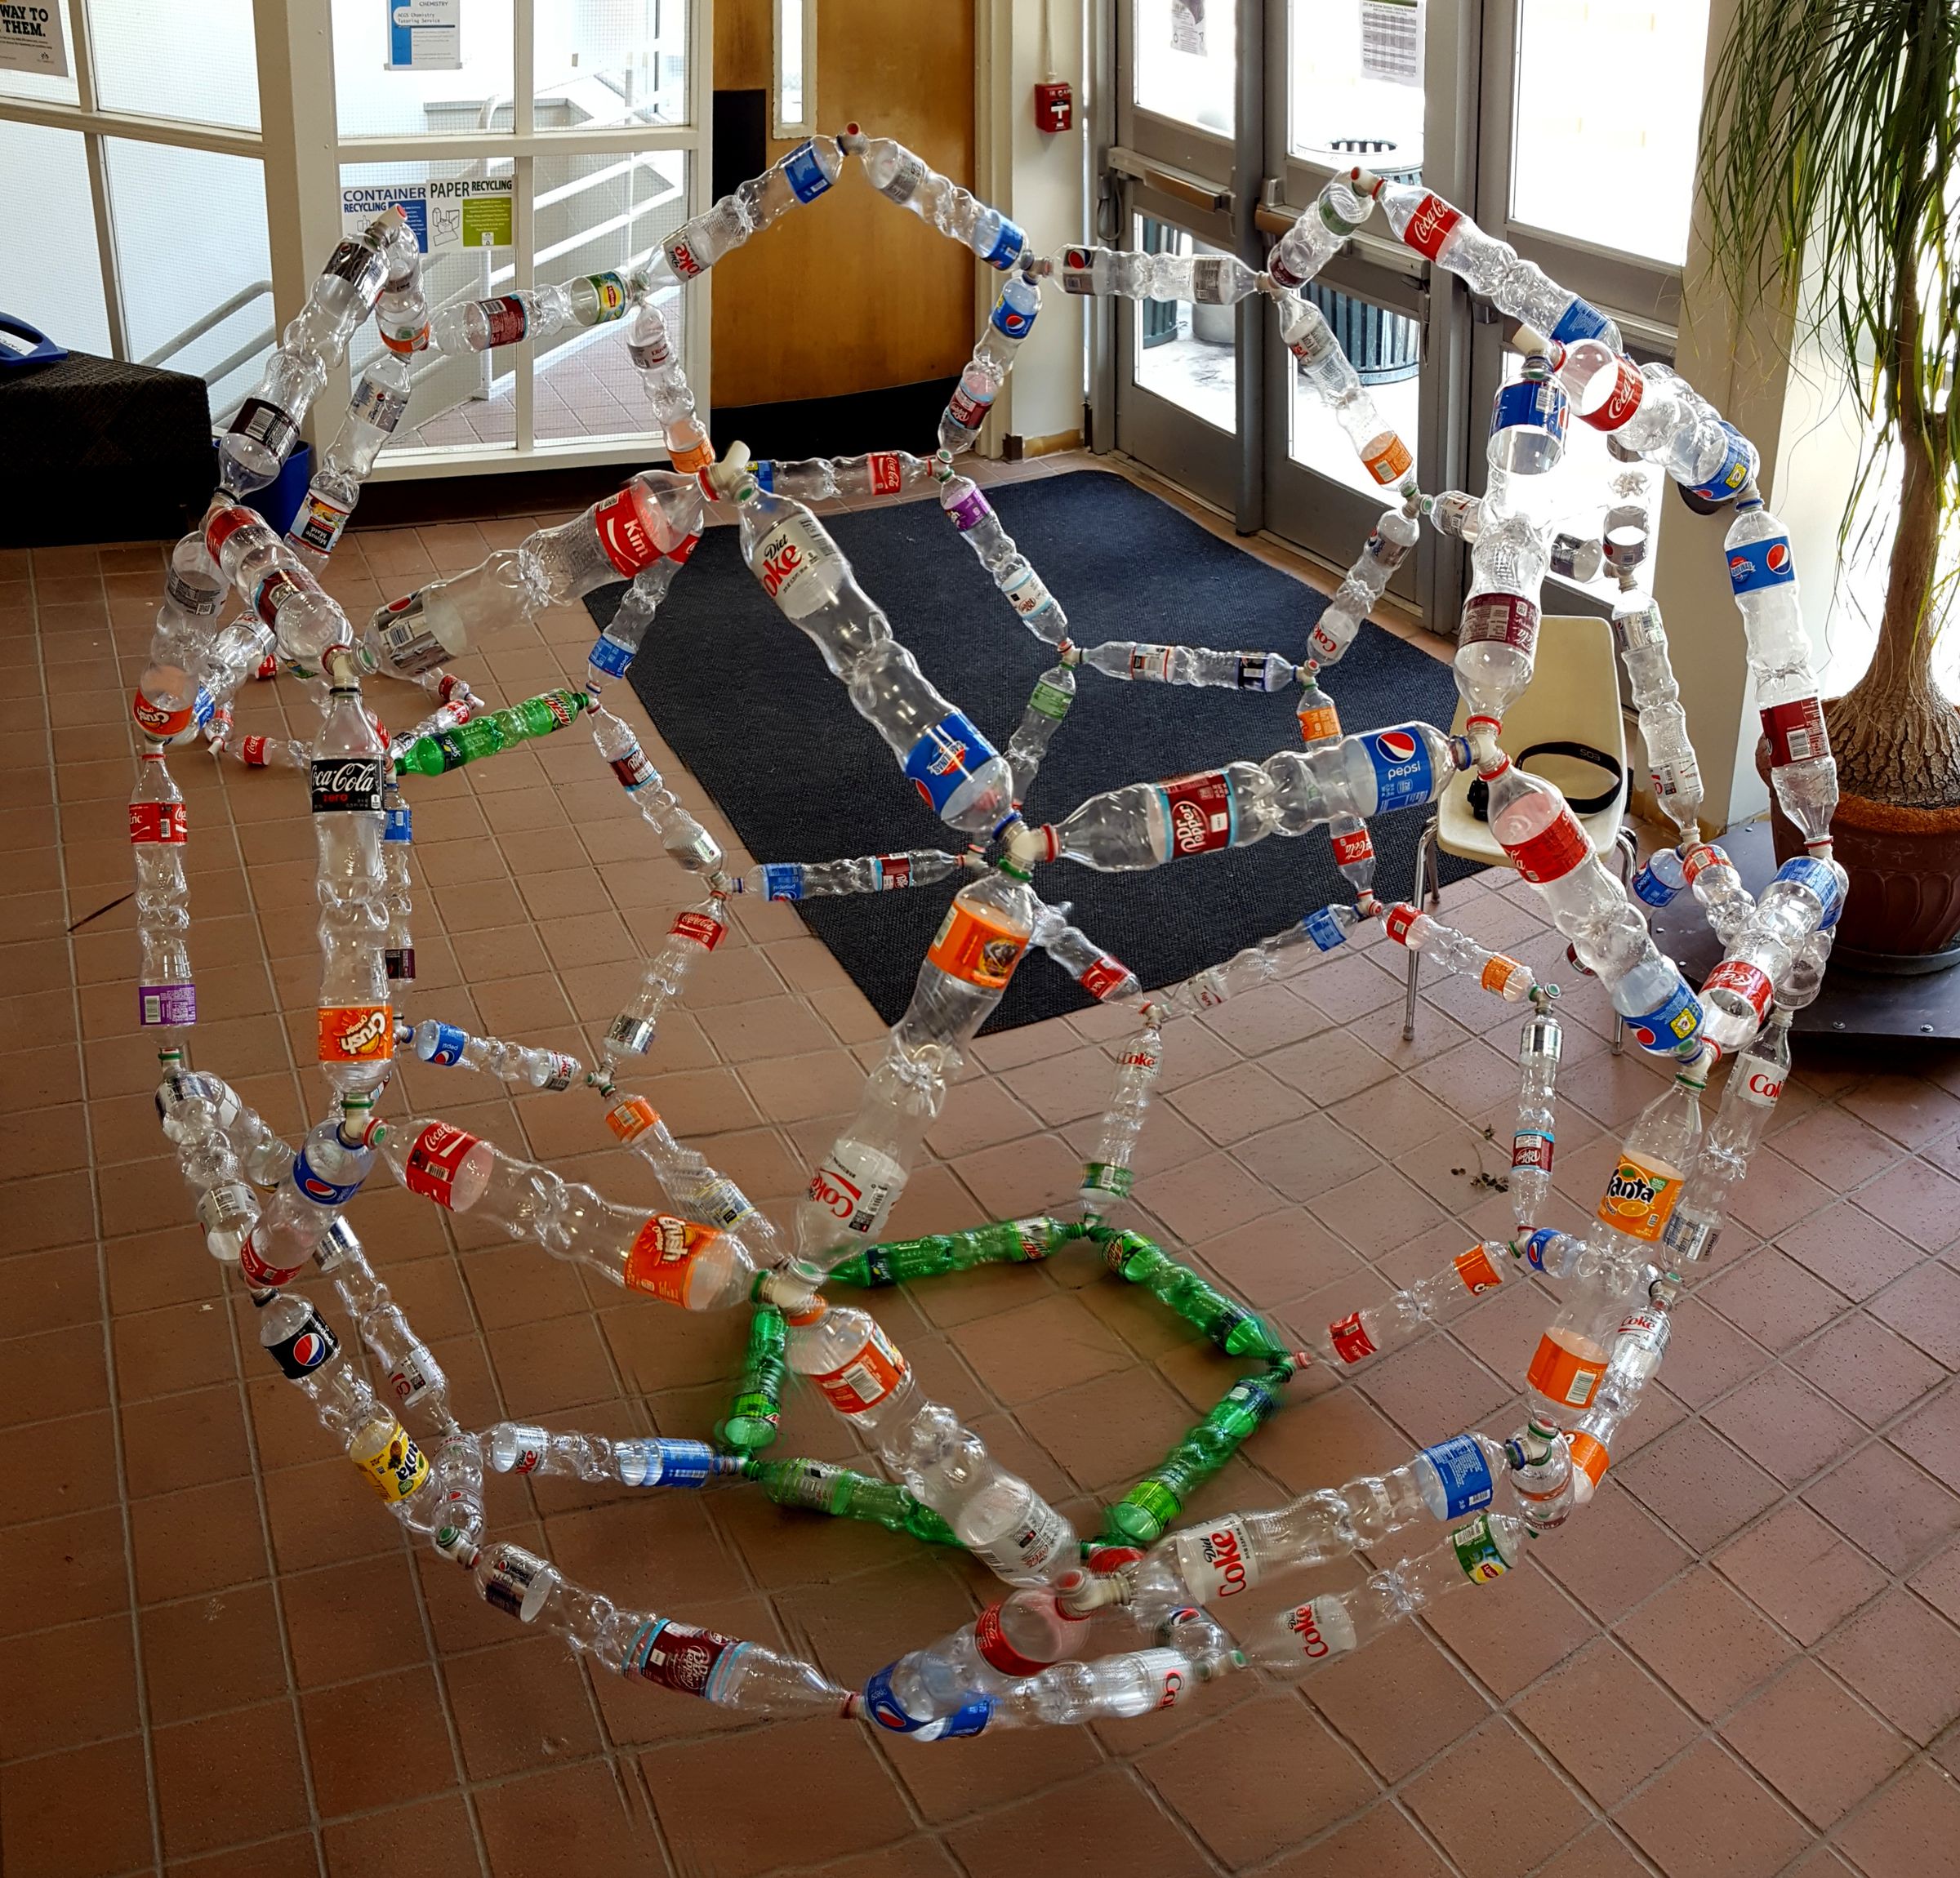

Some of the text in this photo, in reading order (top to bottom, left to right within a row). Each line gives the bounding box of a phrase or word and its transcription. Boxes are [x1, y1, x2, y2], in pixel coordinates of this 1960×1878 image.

[0, 5, 49, 22] WAY TO
[3, 20, 47, 38] THEM.
[343, 187, 426, 202] CONTAINER
[430, 180, 512, 198] PAPER RECYCLING
[344, 202, 386, 213] RECYCLING
[305, 531, 327, 545] Minute
[310, 527, 328, 538] Maid
[622, 518, 648, 559] Kim
[764, 534, 789, 560] Diet
[1388, 763, 1421, 781] pepsi
[323, 793, 348, 803] zero
[340, 1011, 388, 1055] Crush
[314, 1322, 335, 1345] pepsi
[1200, 1538, 1216, 1564] Diet
[1211, 1529, 1247, 1598] Coke
[1294, 1604, 1330, 1658] Coke
